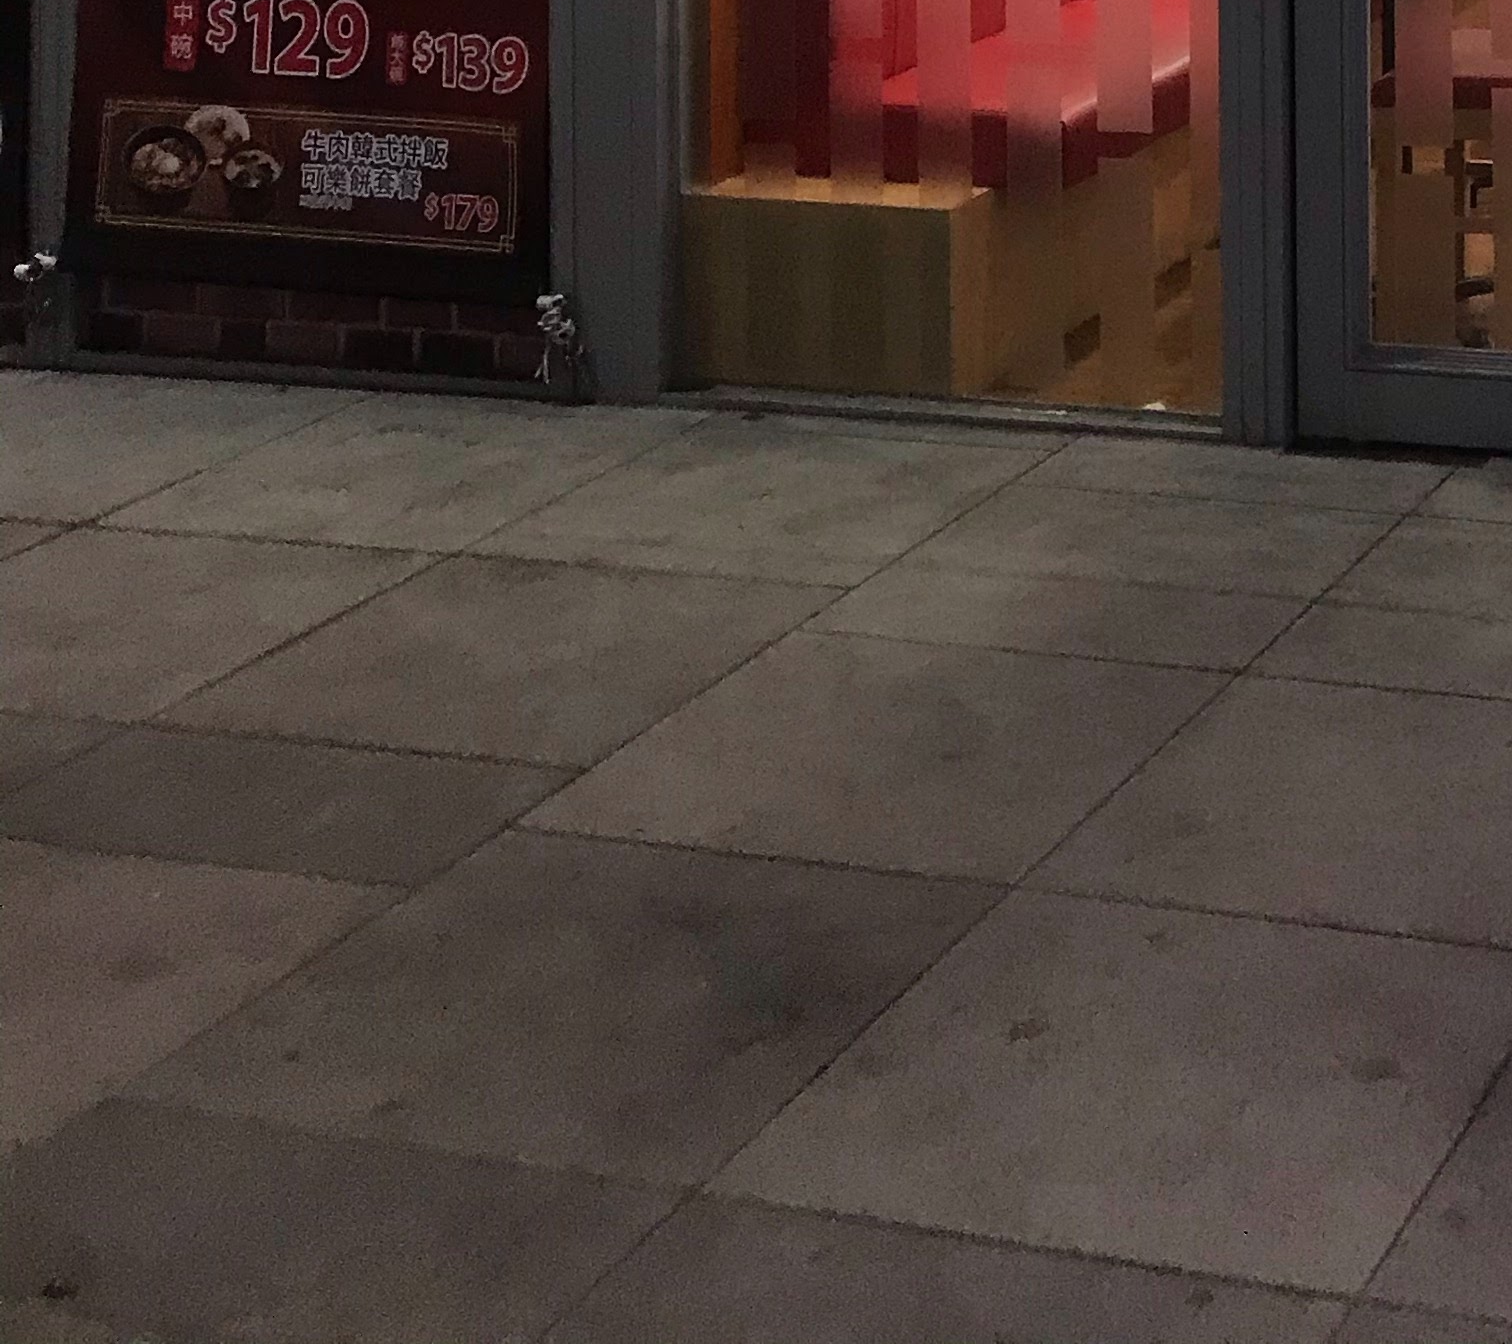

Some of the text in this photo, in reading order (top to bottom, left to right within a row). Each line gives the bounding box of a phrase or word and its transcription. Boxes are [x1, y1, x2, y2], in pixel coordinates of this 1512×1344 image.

[170, 1, 194, 60] 中碗
[412, 30, 530, 96] $139
[301, 128, 449, 170] 牛肉韓式拌飯
[300, 162, 423, 202] 可樂餅套餐
[423, 191, 500, 233] $179
